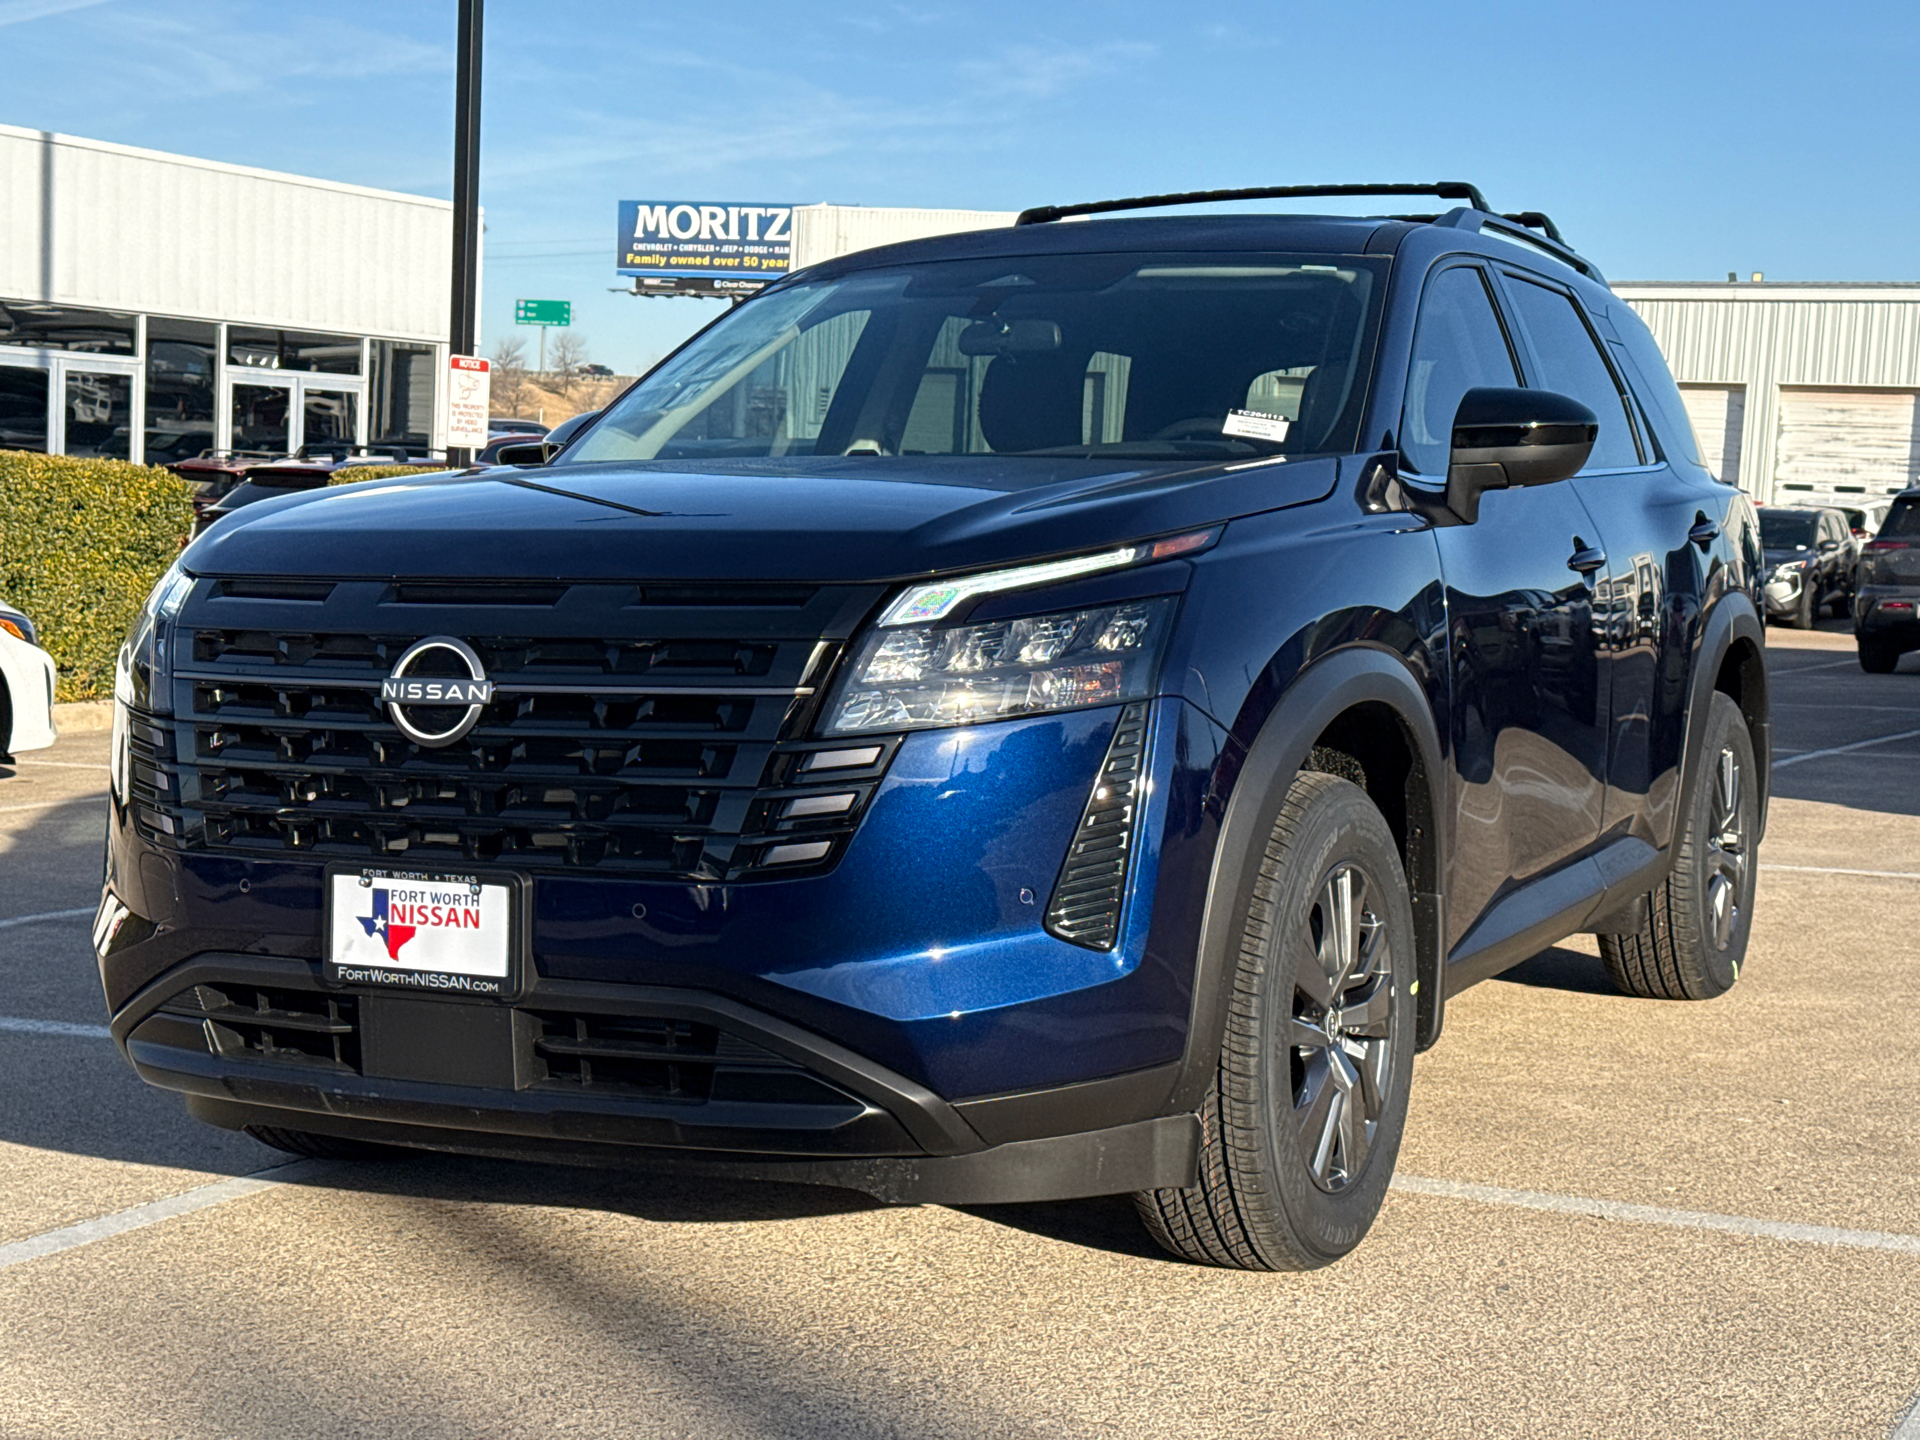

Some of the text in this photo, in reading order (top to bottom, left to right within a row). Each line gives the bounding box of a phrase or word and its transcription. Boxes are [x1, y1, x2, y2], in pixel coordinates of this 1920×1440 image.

[634, 205, 791, 241] MORITZ
[633, 242, 790, 254] CHEVROLET CHRYSLER JEEP DODGE RAM
[626, 253, 667, 267] Family
[669, 255, 710, 266] owned
[713, 257, 740, 266] over
[743, 256, 759, 267] 50
[459, 359, 481, 369] NOTICE
[462, 403, 485, 411] PROPERTY
[383, 682, 488, 700] NISSAN
[362, 868, 477, 884] FORT WORTH TEXAS
[391, 889, 480, 907] FORT WORTH
[391, 903, 480, 929] NISSAN
